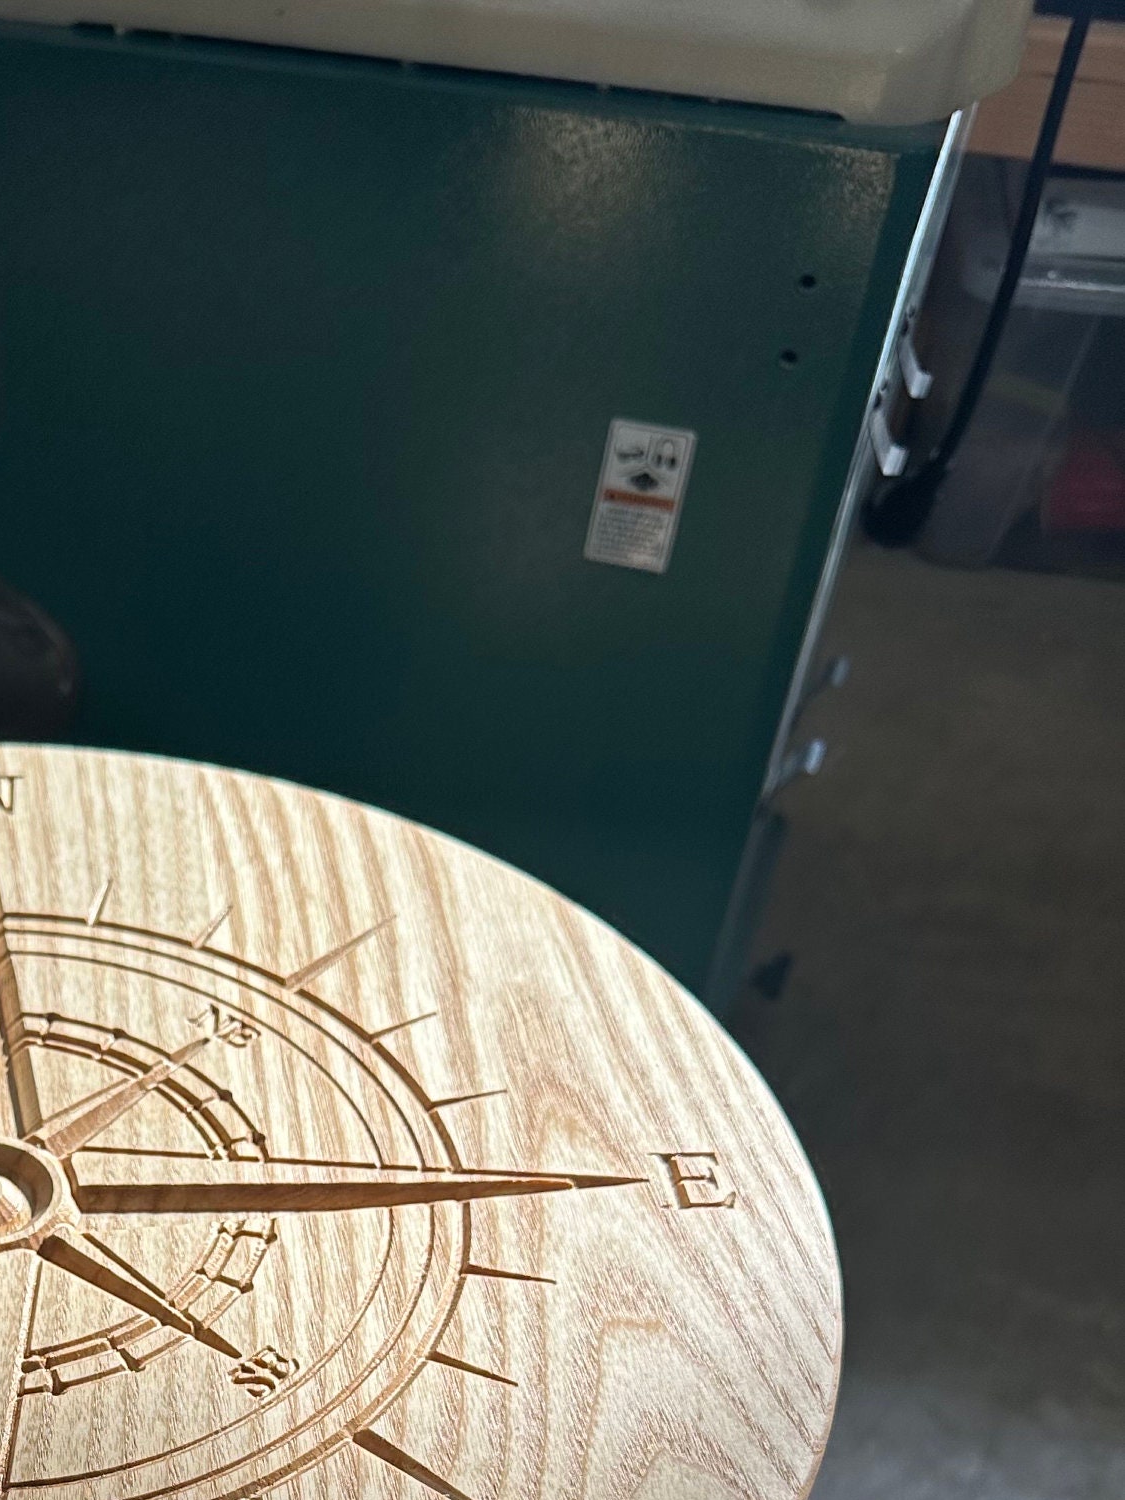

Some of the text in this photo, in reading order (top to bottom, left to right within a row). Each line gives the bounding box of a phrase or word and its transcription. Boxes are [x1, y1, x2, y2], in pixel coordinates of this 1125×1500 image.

[183, 1003, 262, 1048] NE
[645, 1152, 736, 1210] E
[227, 1344, 300, 1400] SE
